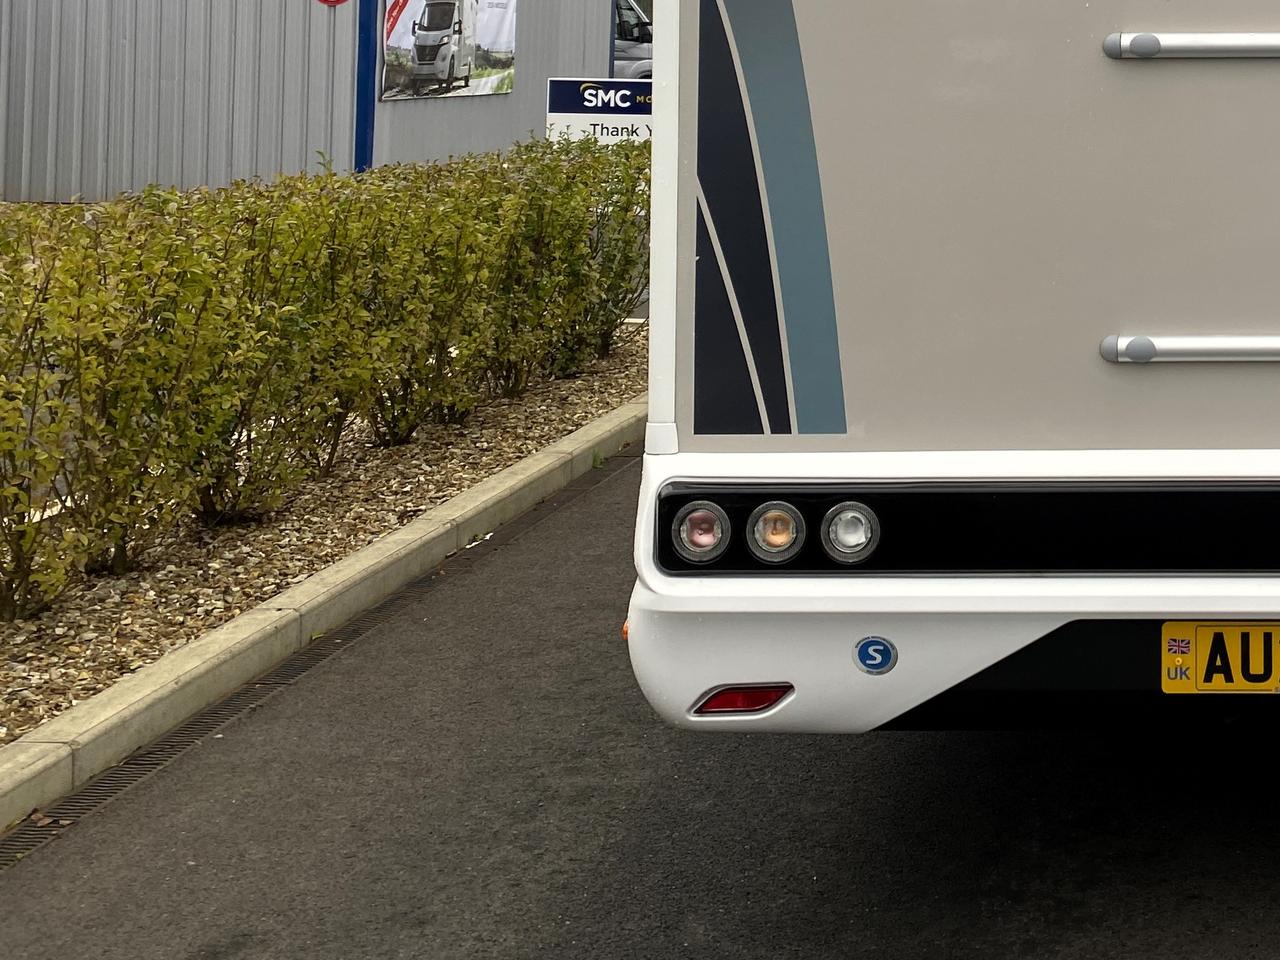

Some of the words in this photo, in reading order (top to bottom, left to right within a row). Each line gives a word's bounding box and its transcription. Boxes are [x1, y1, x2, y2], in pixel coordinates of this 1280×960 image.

[583, 89, 631, 107] SMC
[590, 123, 639, 137] Thank
[865, 645, 883, 664] S
[1167, 666, 1191, 680] UK
